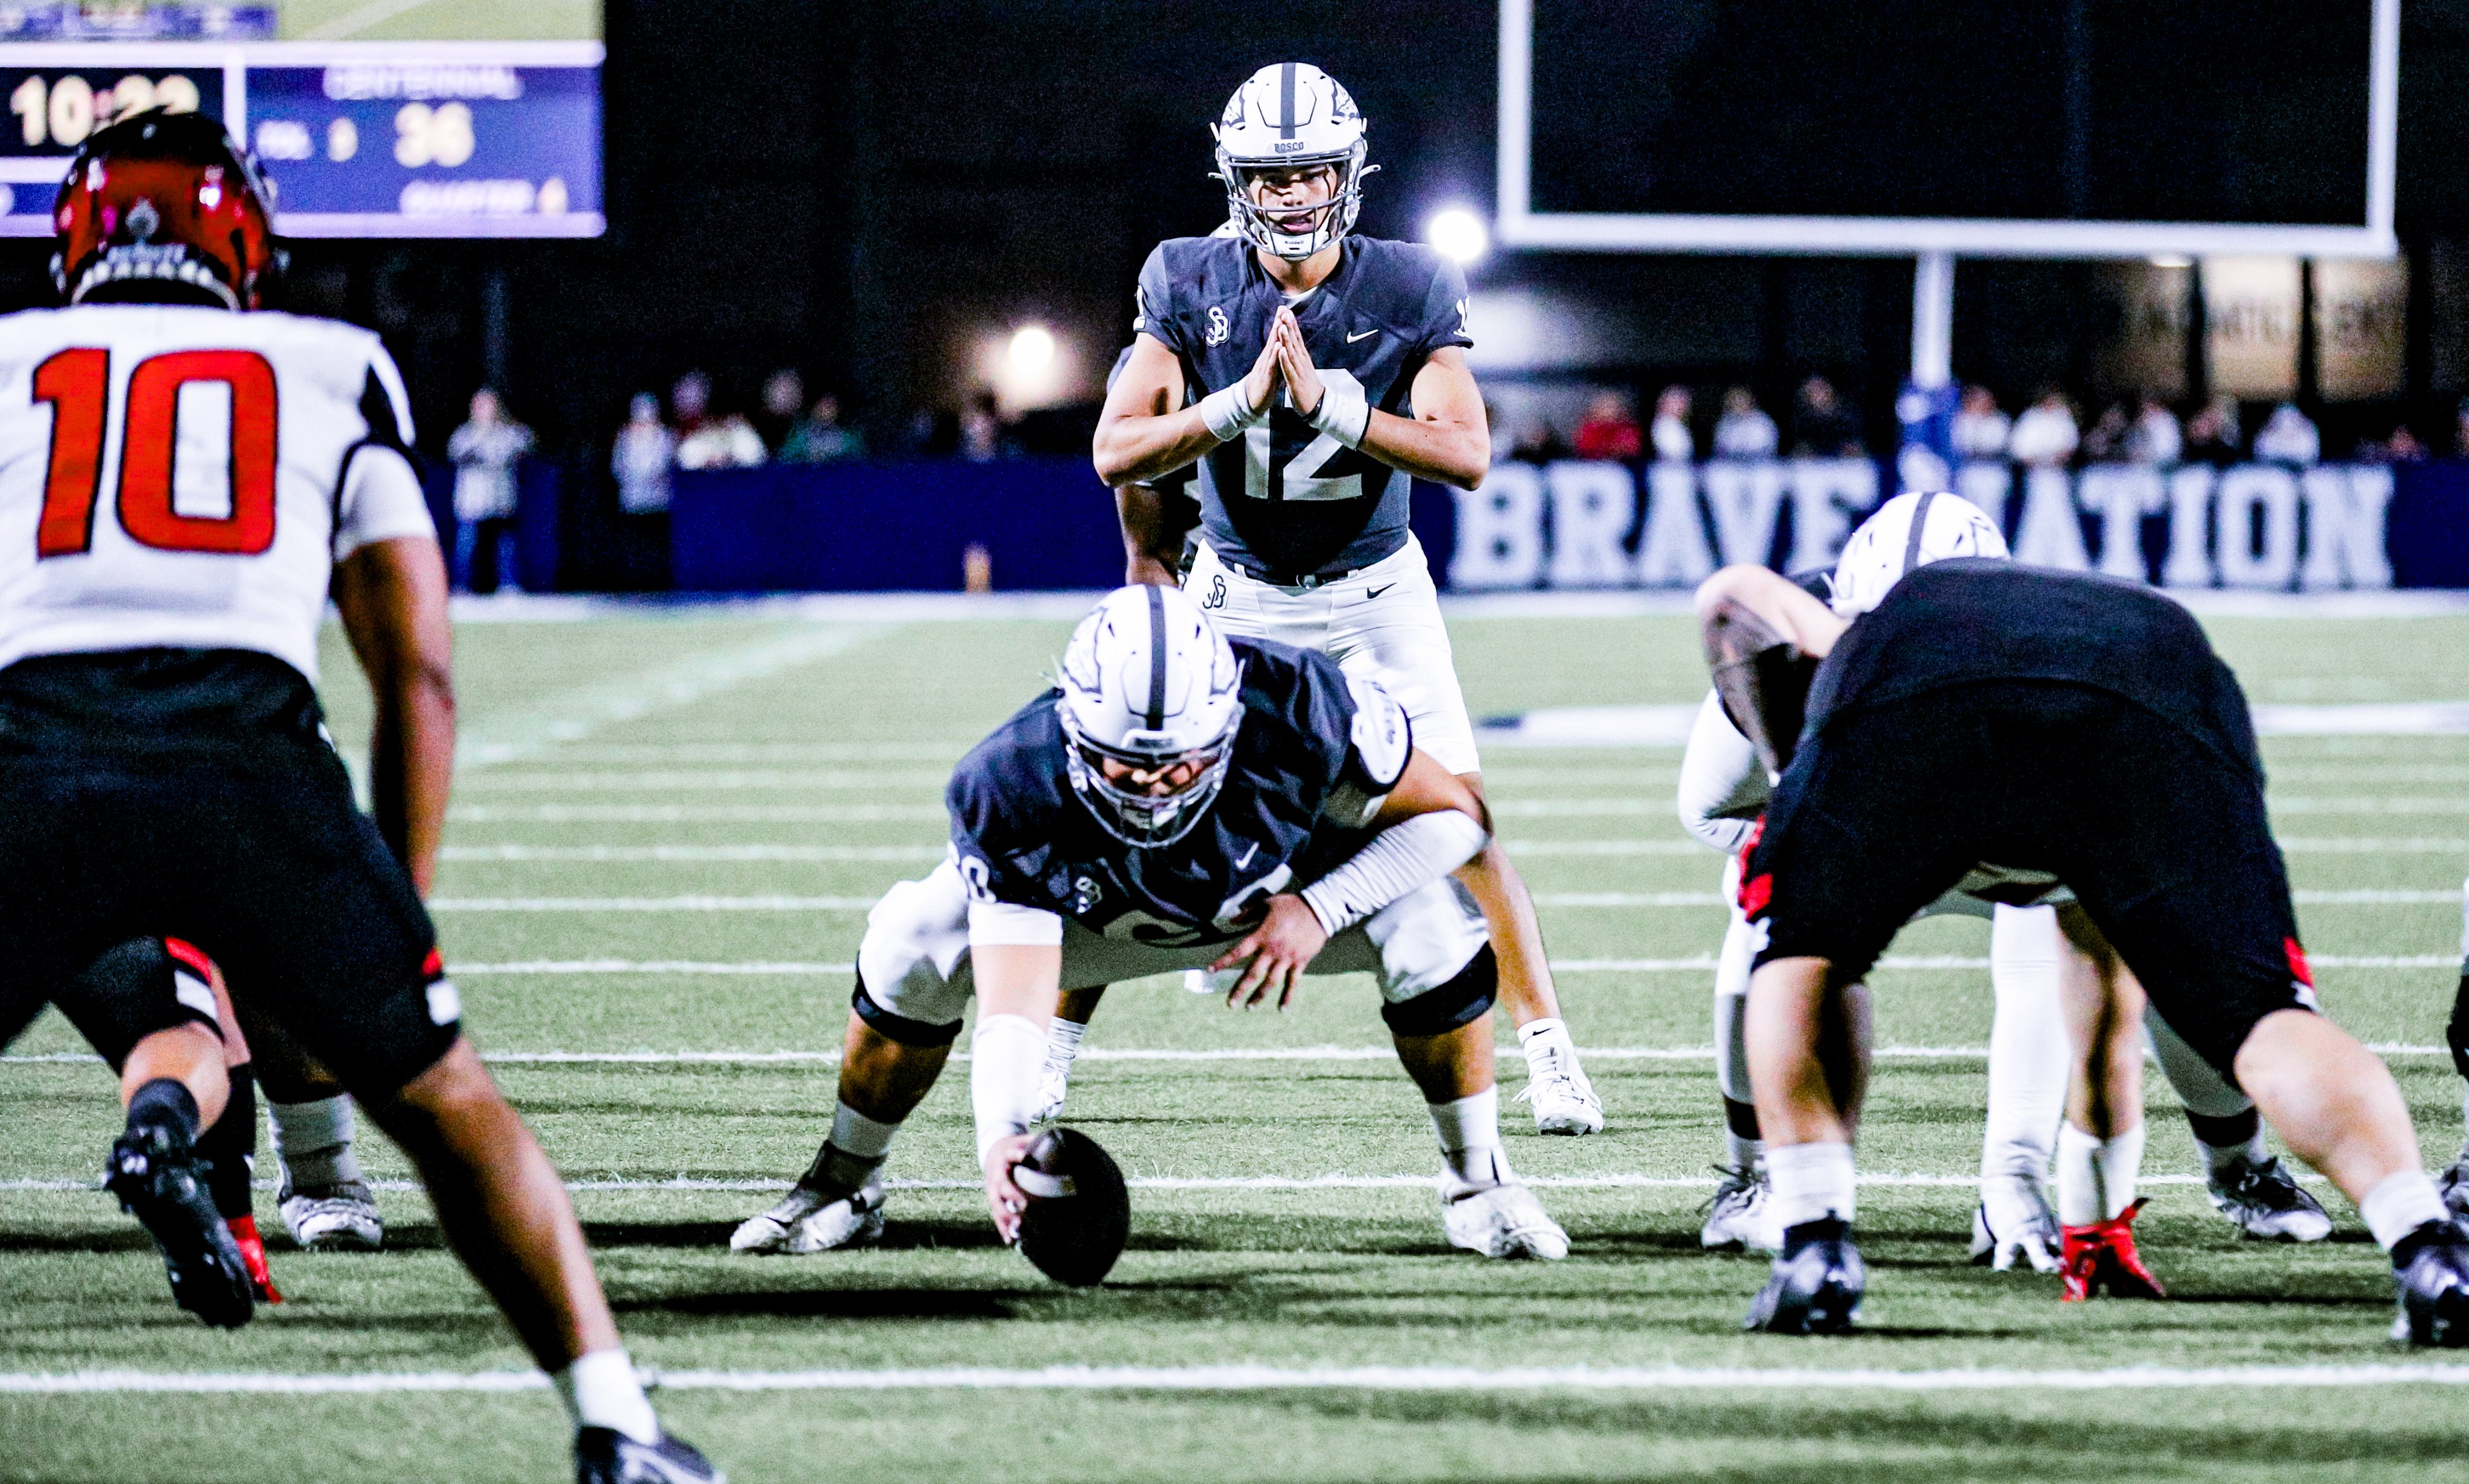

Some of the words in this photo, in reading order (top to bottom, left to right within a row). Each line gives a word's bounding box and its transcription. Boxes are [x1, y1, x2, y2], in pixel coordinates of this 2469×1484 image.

[1274, 141, 1304, 153] BOSCO
[31, 347, 279, 562] 10
[1245, 368, 1367, 501] 12
[1448, 462, 1878, 586] BRAVE
[1955, 463, 2394, 587] ATION
